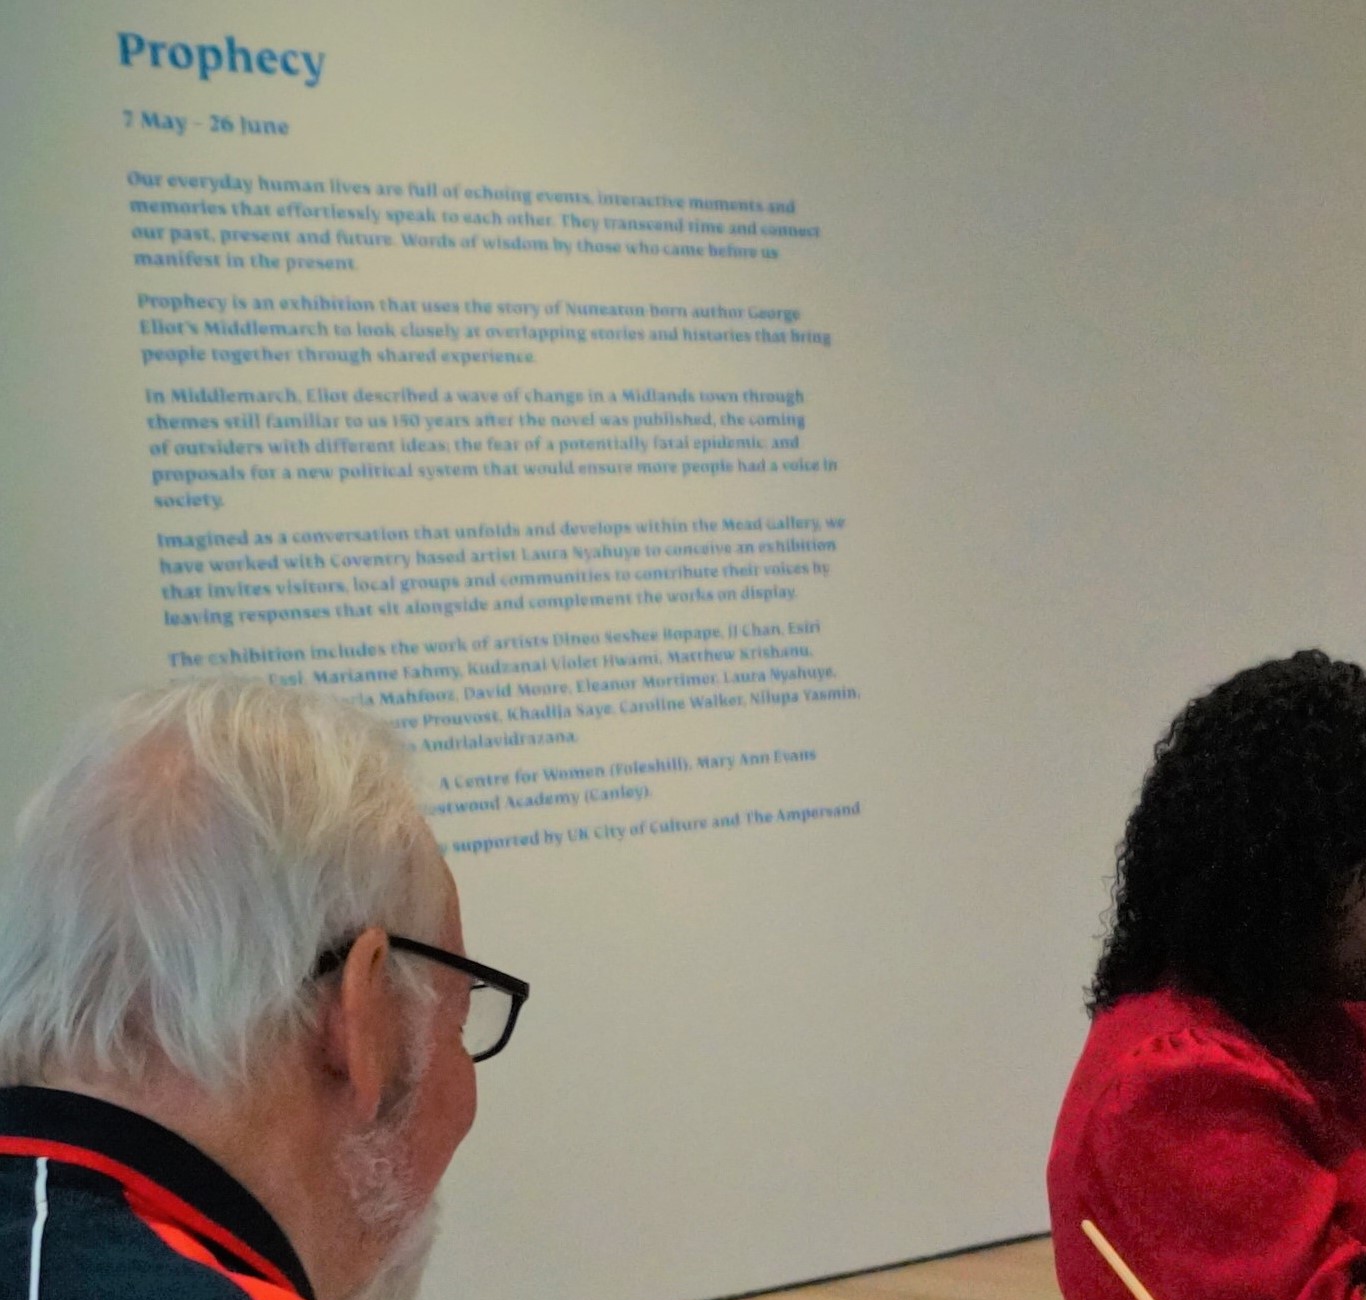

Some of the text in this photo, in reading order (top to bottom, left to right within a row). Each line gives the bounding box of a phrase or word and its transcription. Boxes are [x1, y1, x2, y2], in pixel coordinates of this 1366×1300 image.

[117, 31, 325, 88] Prophecy
[122, 109, 134, 128] 7
[141, 111, 187, 136] May
[209, 113, 235, 132] 26
[240, 115, 289, 136] June
[127, 169, 162, 185] Our
[167, 171, 253, 194] everyday
[257, 175, 325, 193] human
[329, 178, 371, 195] lives
[375, 184, 403, 196] are
[407, 181, 438, 198] full
[442, 183, 460, 199] of
[597, 192, 685, 209] interactive
[688, 196, 763, 212] moments
[766, 197, 795, 213] and
[129, 198, 228, 215] memories
[231, 200, 271, 216] that
[276, 201, 380, 224] effortlessly
[385, 205, 436, 226] speak
[442, 209, 460, 223] to
[462, 208, 502, 225] each
[561, 212, 600, 233] They
[603, 214, 685, 232] transcend
[687, 219, 724, 234] time
[729, 219, 757, 235] and
[760, 222, 820, 238] connect
[132, 227, 165, 239] our
[219, 227, 291, 247] present
[297, 228, 332, 244] and
[402, 231, 457, 248] Words
[460, 233, 478, 248] of
[483, 234, 549, 251] wisdom
[552, 236, 572, 256] by
[576, 237, 621, 253] those
[626, 238, 660, 255] who
[664, 244, 704, 256] came
[707, 241, 757, 258] before
[760, 247, 780, 259] us
[134, 251, 220, 267] manifest
[226, 254, 245, 267] in
[250, 252, 280, 267] the
[137, 291, 227, 312] Prophecy
[231, 295, 247, 308] is
[252, 298, 274, 309] an
[279, 294, 374, 311] exhibition
[379, 296, 417, 312] that
[421, 301, 460, 313] uses
[464, 298, 492, 314] the
[496, 301, 540, 319] story
[544, 300, 561, 315] of
[649, 302, 687, 317] born
[691, 302, 744, 318] author
[747, 303, 799, 323] George
[203, 319, 328, 336] Middlemarch
[334, 323, 352, 336] to
[356, 321, 395, 337] look
[400, 322, 460, 342] closely
[464, 325, 481, 338] at
[485, 323, 588, 344] overlapping
[590, 327, 644, 340] stories
[649, 326, 679, 341] and
[681, 326, 751, 342] histories
[755, 327, 787, 342] that
[789, 327, 831, 347] bring
[141, 345, 206, 364] people
[211, 345, 290, 365] together
[297, 346, 371, 366] through
[377, 347, 437, 362] shared
[146, 386, 166, 402] In
[306, 387, 349, 402] Eliot
[353, 387, 440, 402] described
[457, 391, 499, 402] wave
[503, 387, 521, 402] of
[525, 387, 583, 406] change
[587, 389, 604, 402] in
[621, 387, 695, 402] Midlands
[699, 389, 739, 402] town
[741, 387, 804, 406] through
[157, 530, 249, 553] Imagined
[253, 533, 273, 545] as
[292, 526, 409, 543] conversation
[413, 523, 450, 539] that
[455, 521, 520, 538] unfolds
[524, 520, 556, 536] and
[560, 518, 631, 539] develops
[635, 517, 687, 533] within
[692, 516, 718, 532] the
[826, 518, 844, 529] we
[163, 607, 235, 629] leaving
[238, 607, 330, 626] responses
[335, 601, 373, 617] that
[378, 601, 400, 615] sit
[405, 596, 487, 618] alongside
[494, 594, 525, 610] and
[528, 589, 632, 613] complement
[636, 588, 662, 604] the
[667, 586, 714, 603] works
[717, 589, 737, 601] on
[168, 650, 204, 667] The
[208, 644, 305, 665] exhibition
[310, 640, 385, 659] includes
[390, 638, 418, 654] the
[423, 635, 467, 653] work
[471, 634, 490, 650] of
[494, 633, 549, 649] artists
[454, 769, 510, 789] Centre
[514, 767, 538, 783] for
[542, 761, 605, 781] Women
[696, 751, 736, 773] Mary
[739, 748, 770, 765] Ann
[772, 745, 816, 763] Evans
